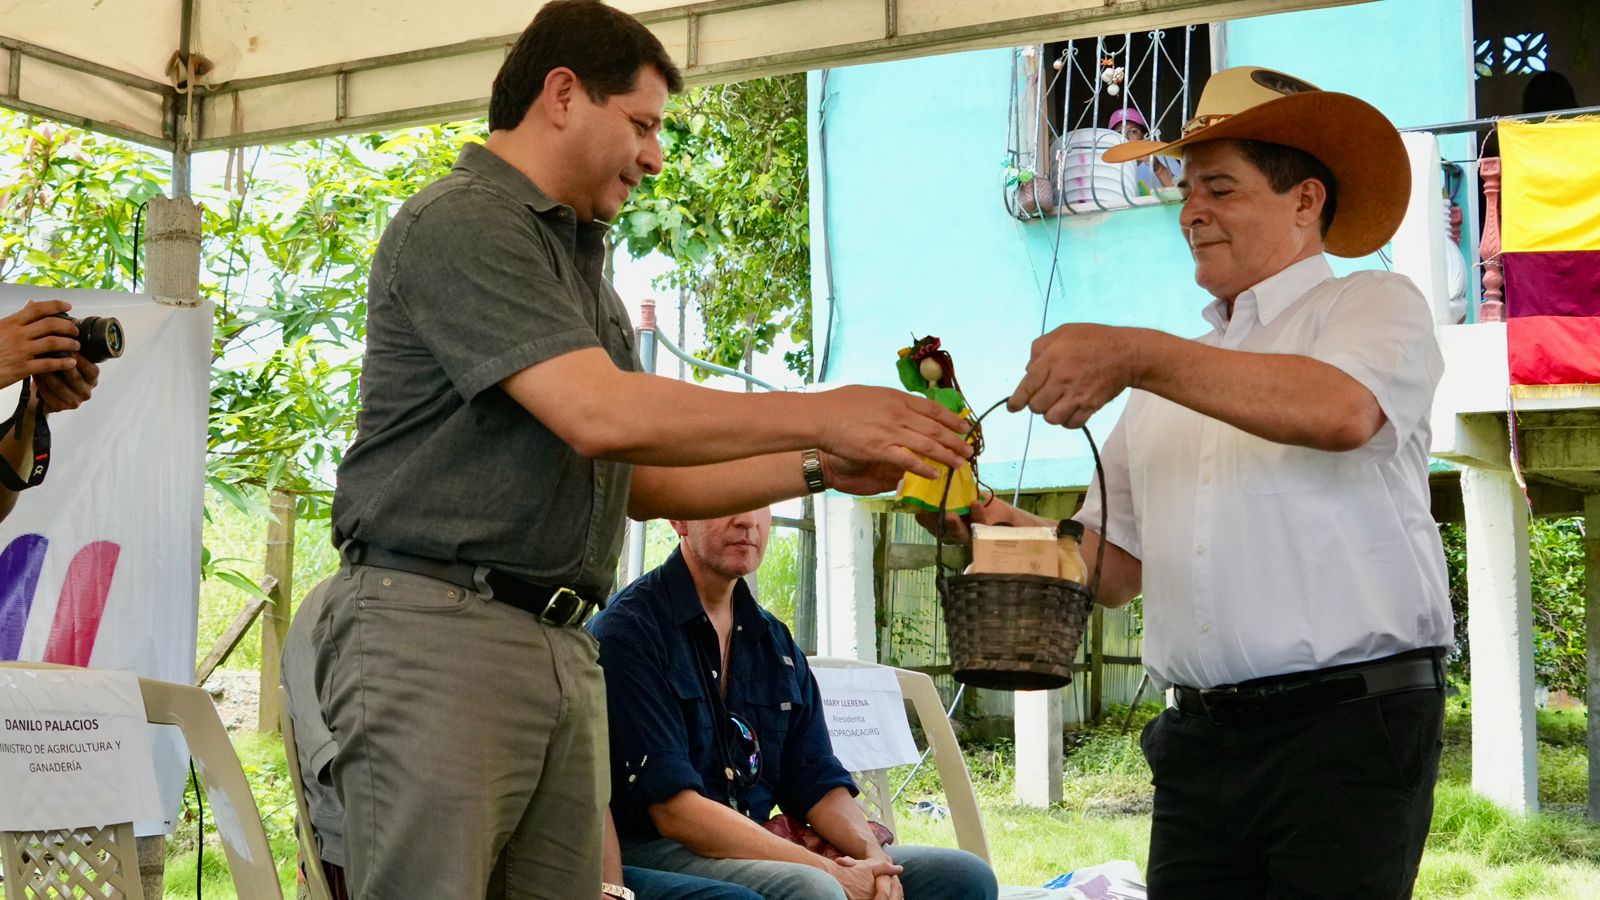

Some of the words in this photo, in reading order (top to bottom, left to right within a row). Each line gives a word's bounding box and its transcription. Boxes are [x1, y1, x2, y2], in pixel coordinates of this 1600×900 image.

[823, 699, 840, 707] MARY
[841, 699, 870, 707] LLERENA
[5, 718, 43, 732] DANILO
[45, 718, 99, 732] PALACIOS
[832, 715, 865, 723] Presidenta
[34, 744, 46, 754] DE
[47, 741, 113, 754] AGRICULTURA
[115, 740, 122, 750] Y
[29, 760, 83, 773] GANADERÍA
